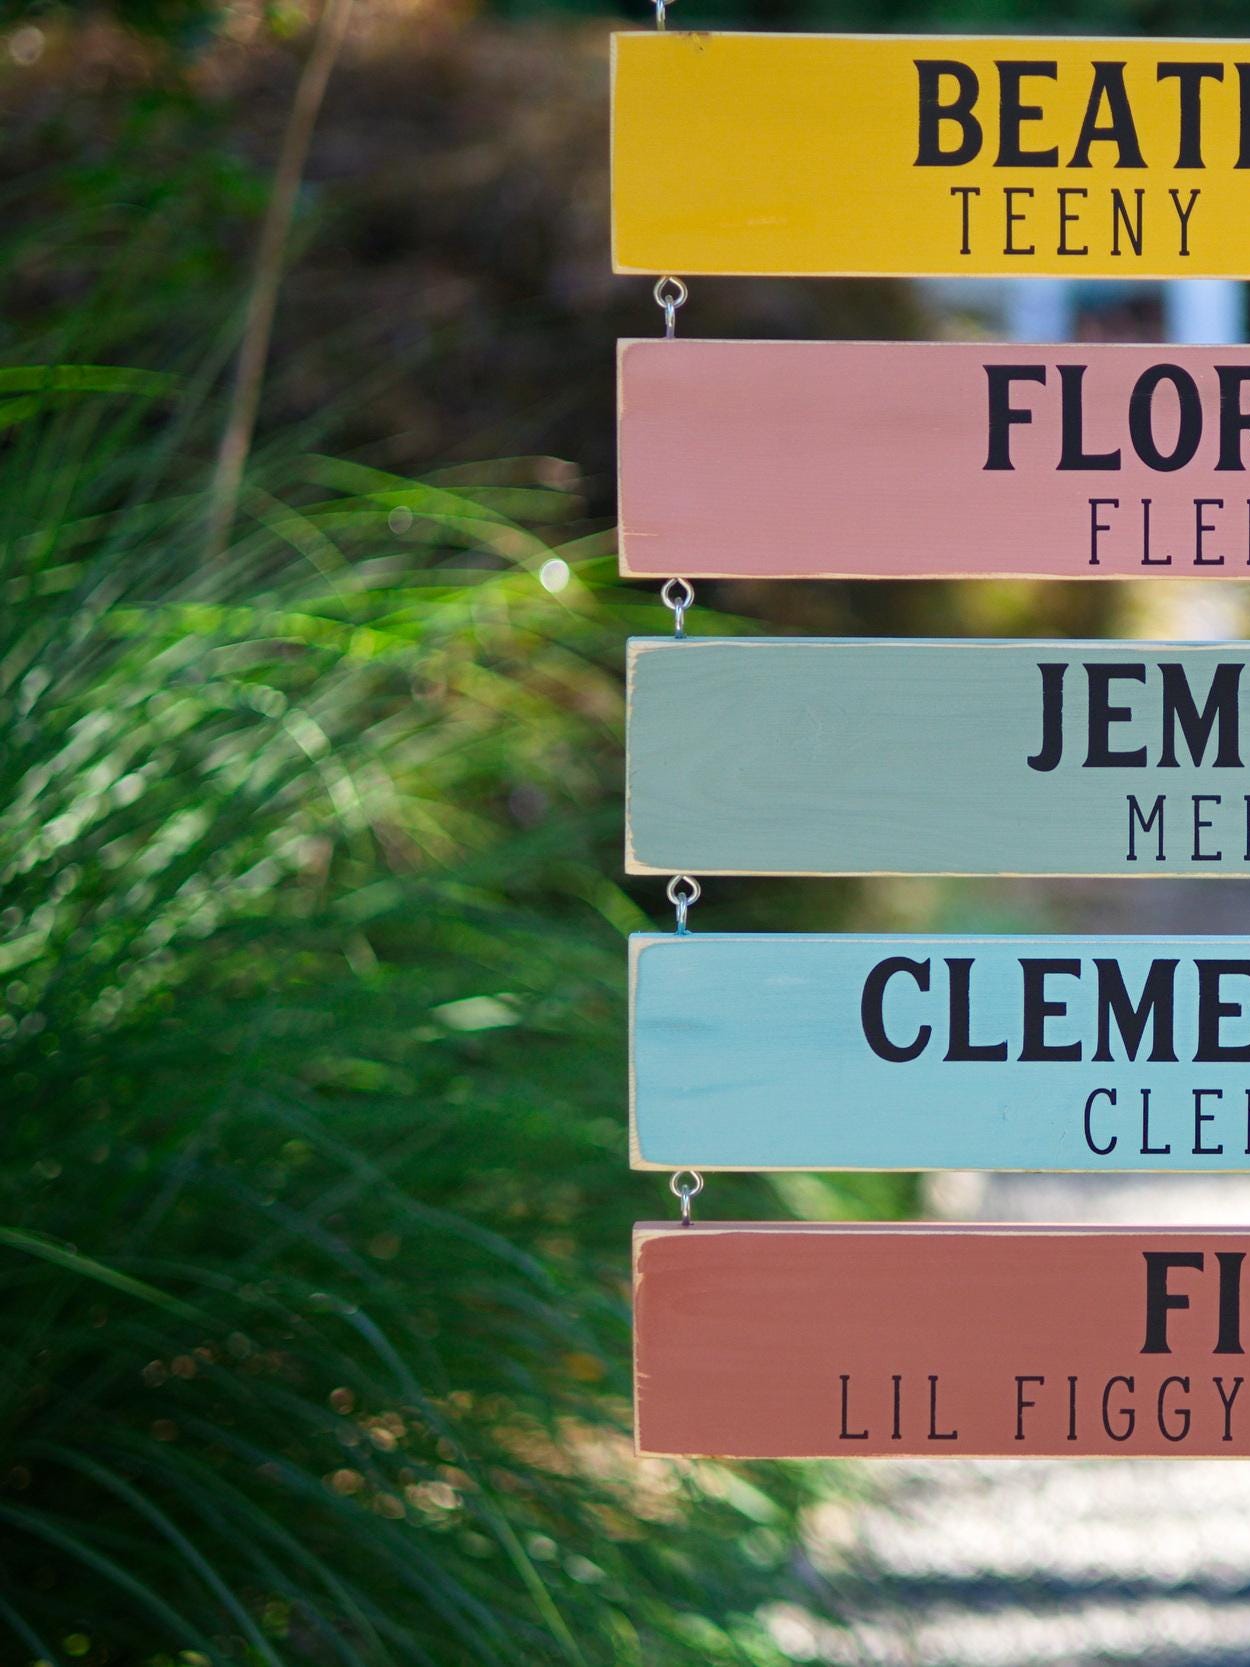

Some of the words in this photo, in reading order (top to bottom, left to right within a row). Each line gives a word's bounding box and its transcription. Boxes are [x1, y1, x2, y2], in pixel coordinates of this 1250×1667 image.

[951, 187, 1200, 256] TEENY
[840, 1375, 958, 1440] LIL
[1015, 1376, 1244, 1441] FIGGY
